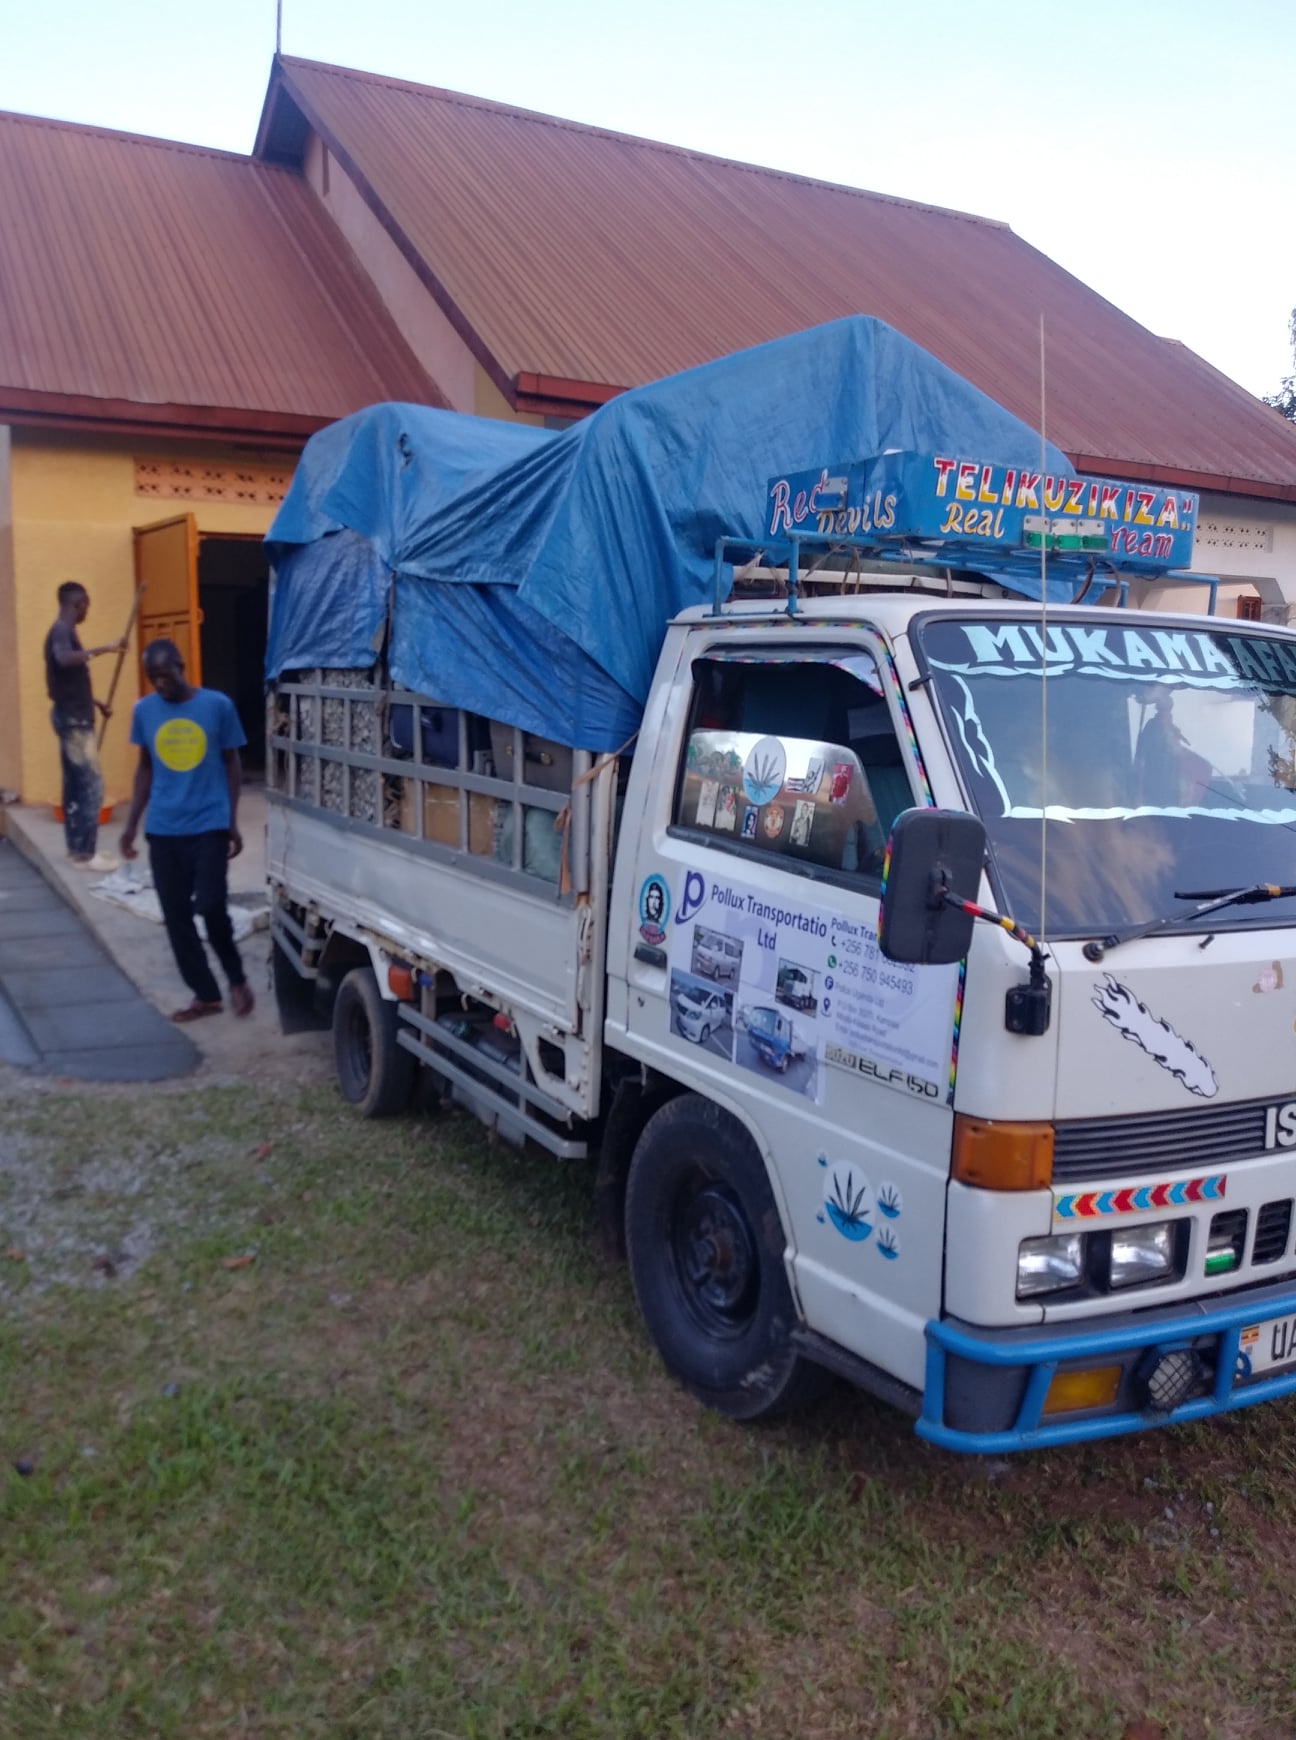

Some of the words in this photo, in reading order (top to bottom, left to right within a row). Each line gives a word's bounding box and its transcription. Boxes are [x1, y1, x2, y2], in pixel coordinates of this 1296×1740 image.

[770, 468, 829, 536] Red
[816, 490, 896, 537] Devils
[940, 502, 1005, 538] Real
[1110, 524, 1174, 558] Team
[960, 625, 1240, 676] MUKAMA
[1226, 637, 1296, 683] AFA
[711, 884, 745, 911] Pollux
[747, 894, 828, 938] Transportatio
[831, 916, 858, 936] Pollux
[757, 928, 777, 950] Ltd
[838, 959, 859, 978] +256
[859, 1057, 904, 1083] ELF
